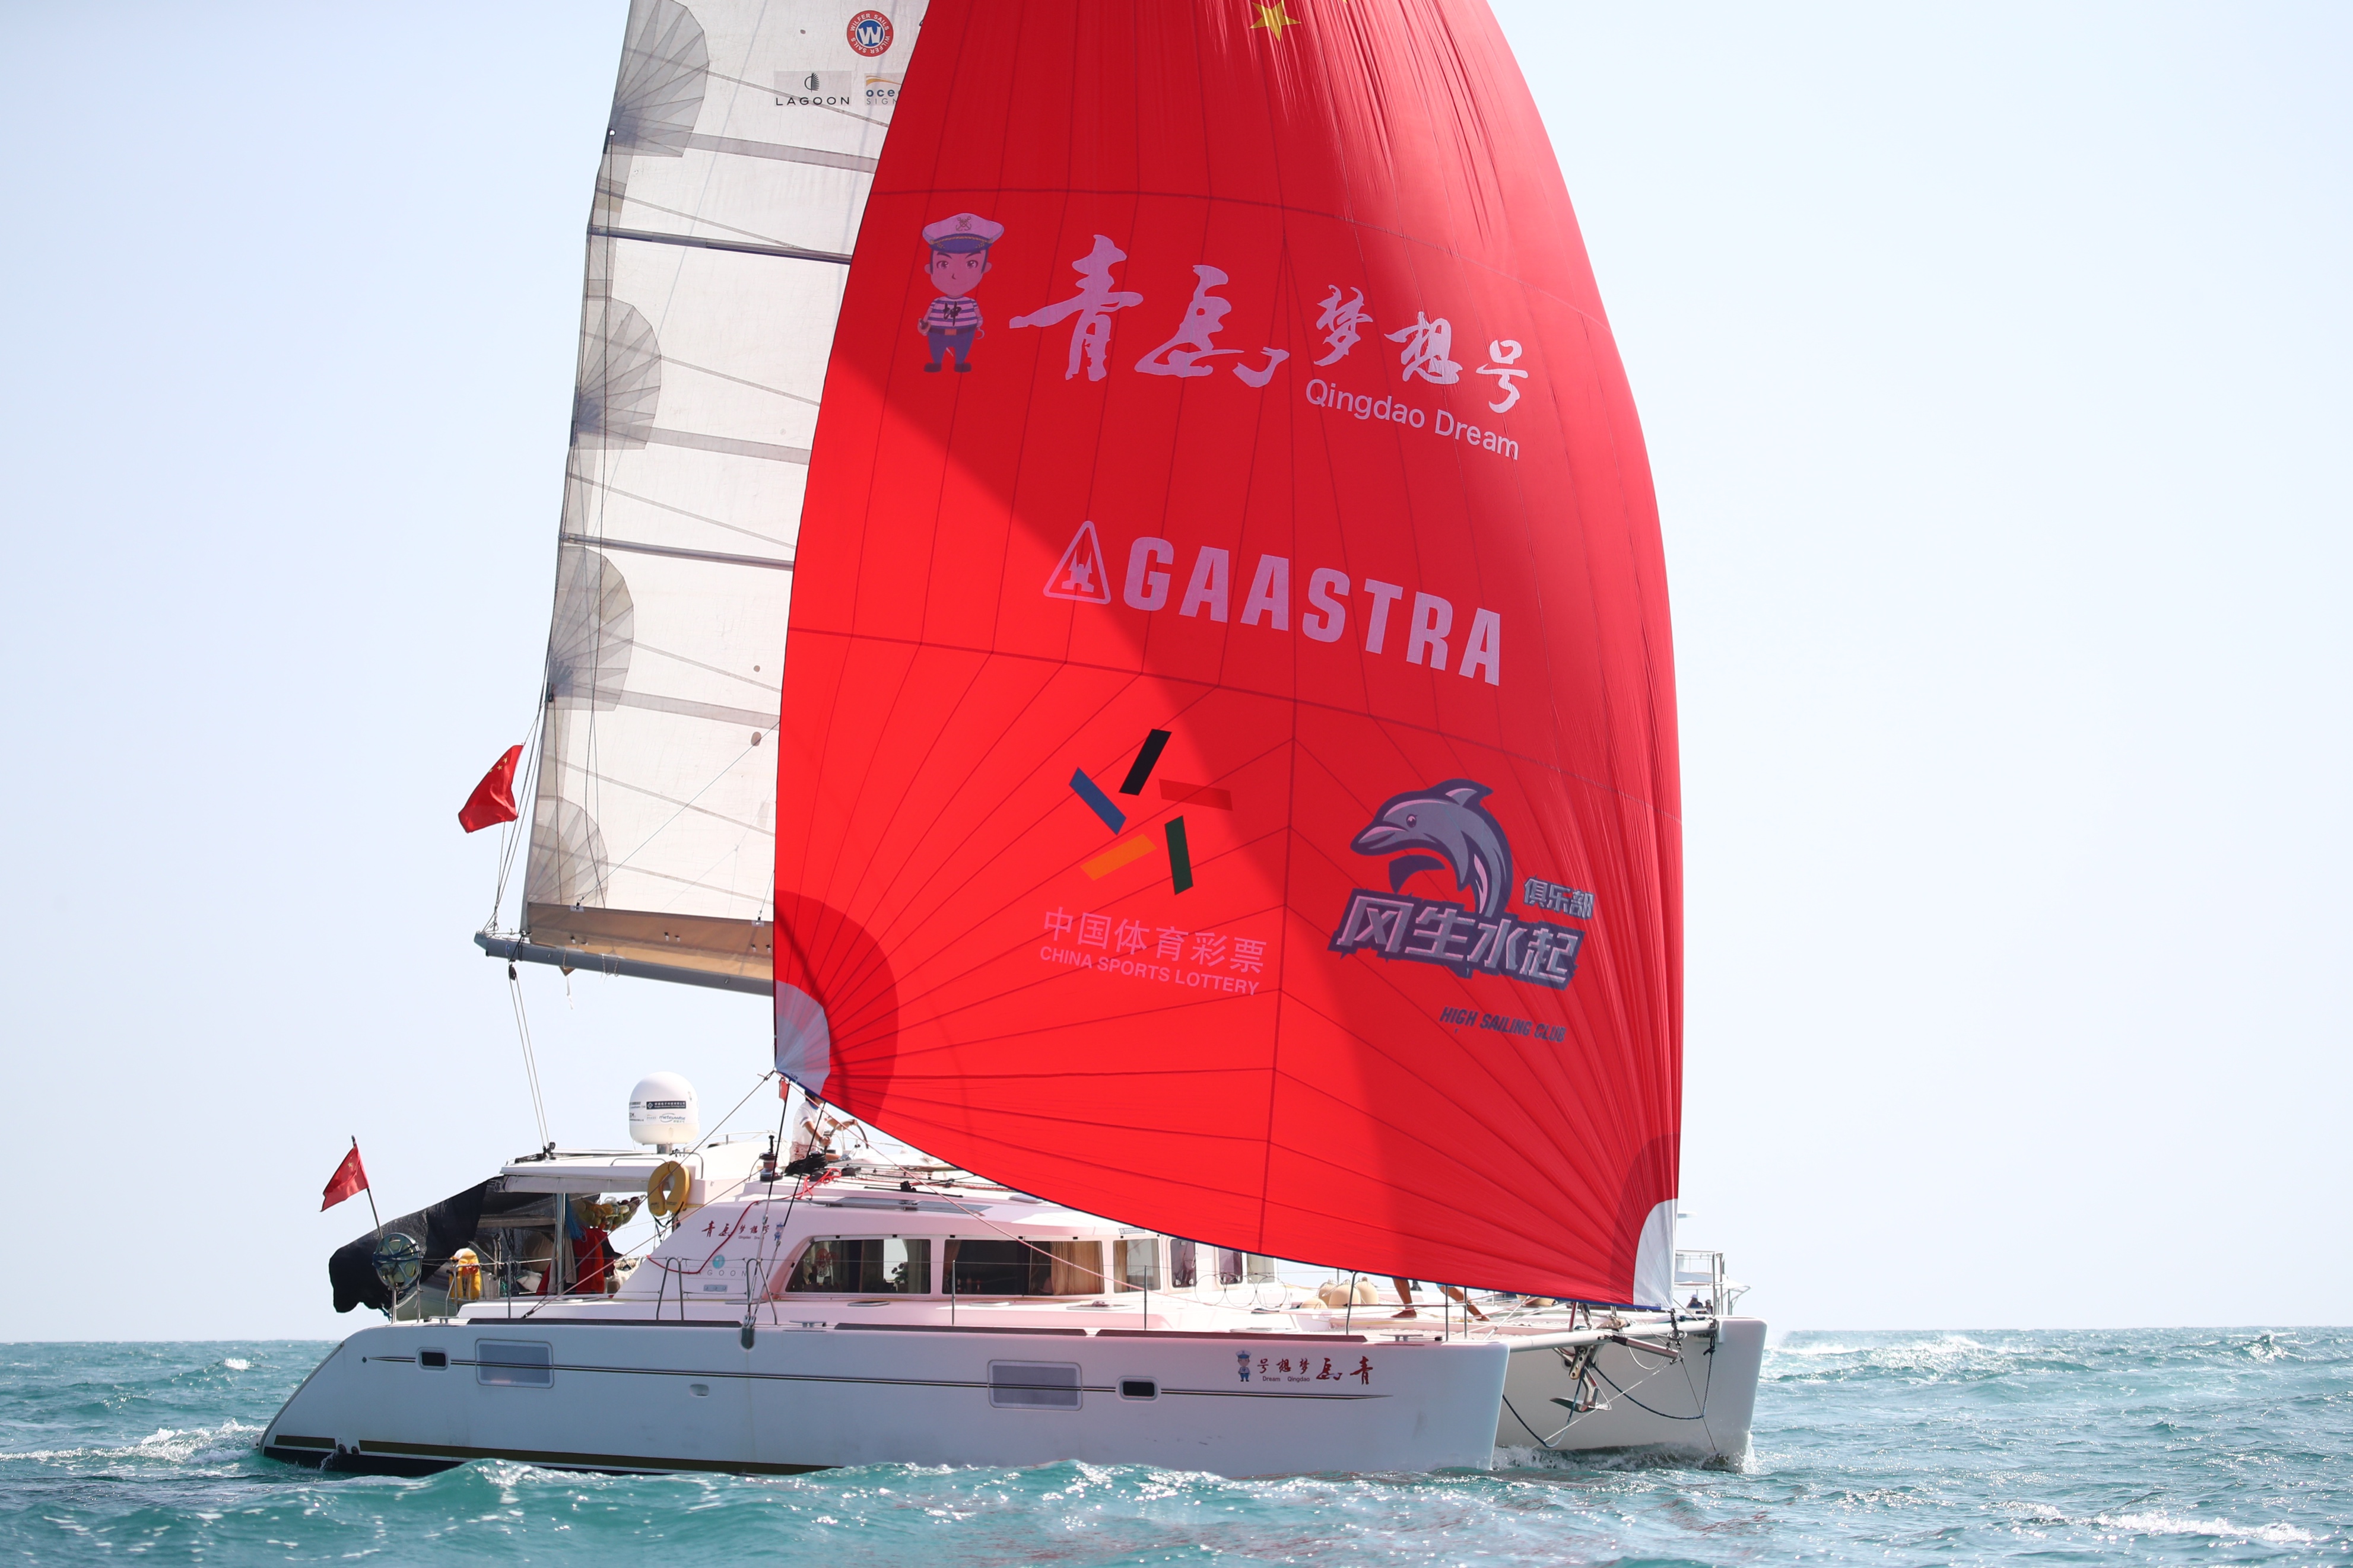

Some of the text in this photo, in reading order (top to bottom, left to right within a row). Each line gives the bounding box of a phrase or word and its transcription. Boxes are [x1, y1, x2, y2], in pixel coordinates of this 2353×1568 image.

[850, 13, 890, 31] WILFER SAILS
[858, 26, 882, 45] W
[850, 36, 891, 54] WILFER SAILS
[776, 97, 850, 106] LAGOON
[1306, 379, 1519, 460] Qingdao Dream
[1123, 536, 1500, 686] GAASTRA
[1523, 877, 1595, 920] 俱乐部
[1043, 907, 1267, 974] 中国体育彩票
[1336, 895, 1579, 984] 风生水起
[1040, 946, 1260, 996] CHINA SPORTS LOTTERY
[1439, 1006, 1567, 1042] HIGH SAILING CLUB
